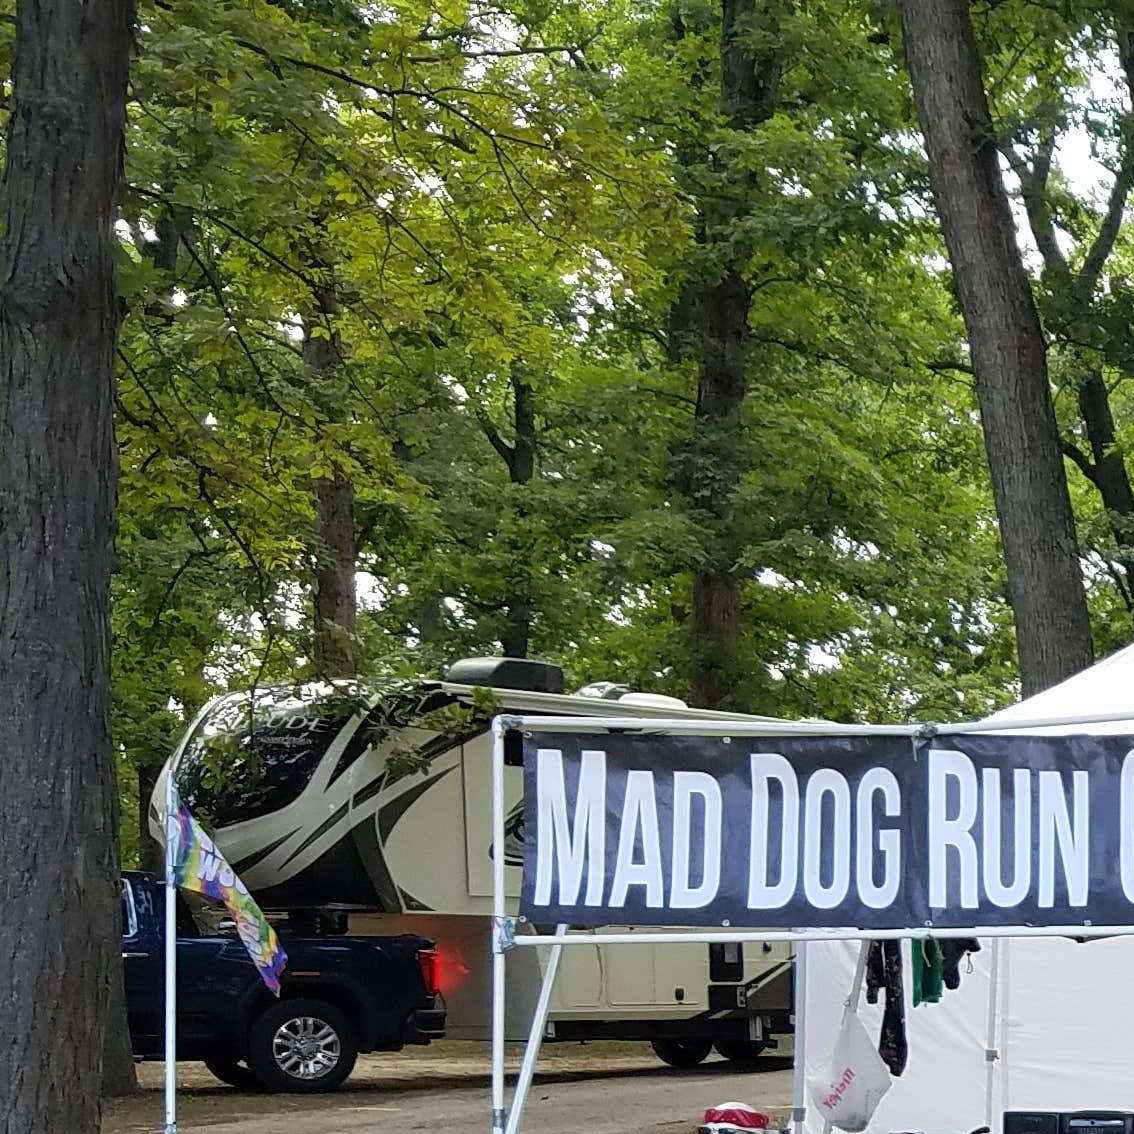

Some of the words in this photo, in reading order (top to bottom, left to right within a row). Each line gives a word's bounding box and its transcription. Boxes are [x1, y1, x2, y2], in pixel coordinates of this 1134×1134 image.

[534, 749, 723, 909] MAD
[747, 753, 901, 909] DOG
[928, 749, 1090, 909] RUN
